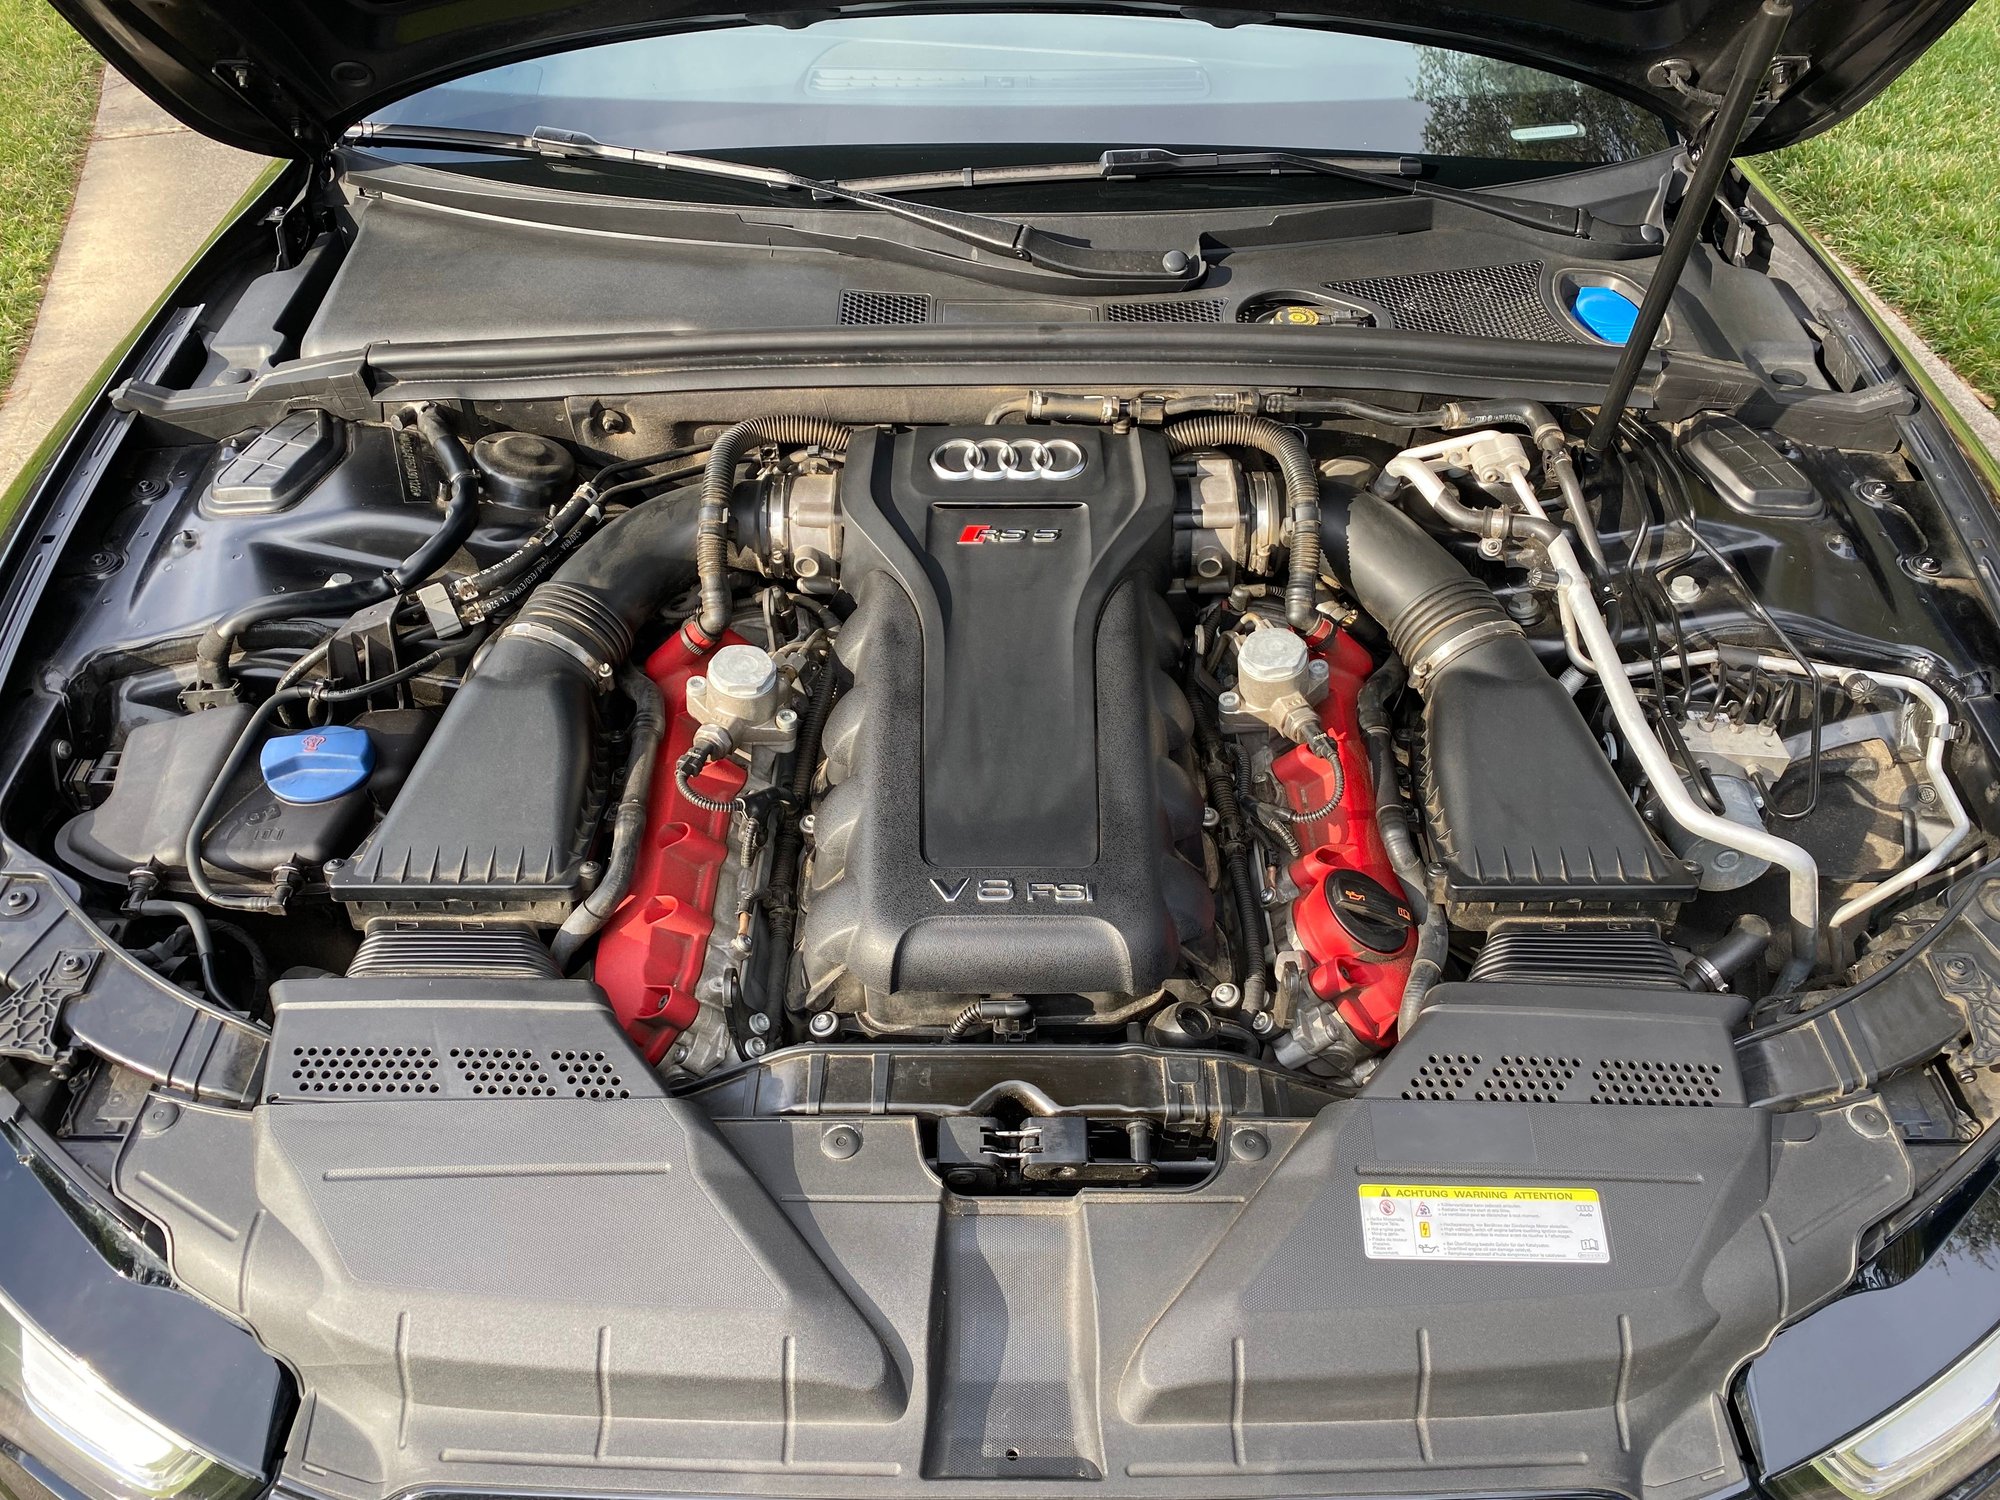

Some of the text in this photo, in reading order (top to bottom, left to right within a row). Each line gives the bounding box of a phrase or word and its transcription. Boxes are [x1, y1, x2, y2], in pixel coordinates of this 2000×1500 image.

[1026, 881, 1094, 902] FSI
[1396, 1189, 1573, 1200] ACHTUNG WARNING ATTENTION
